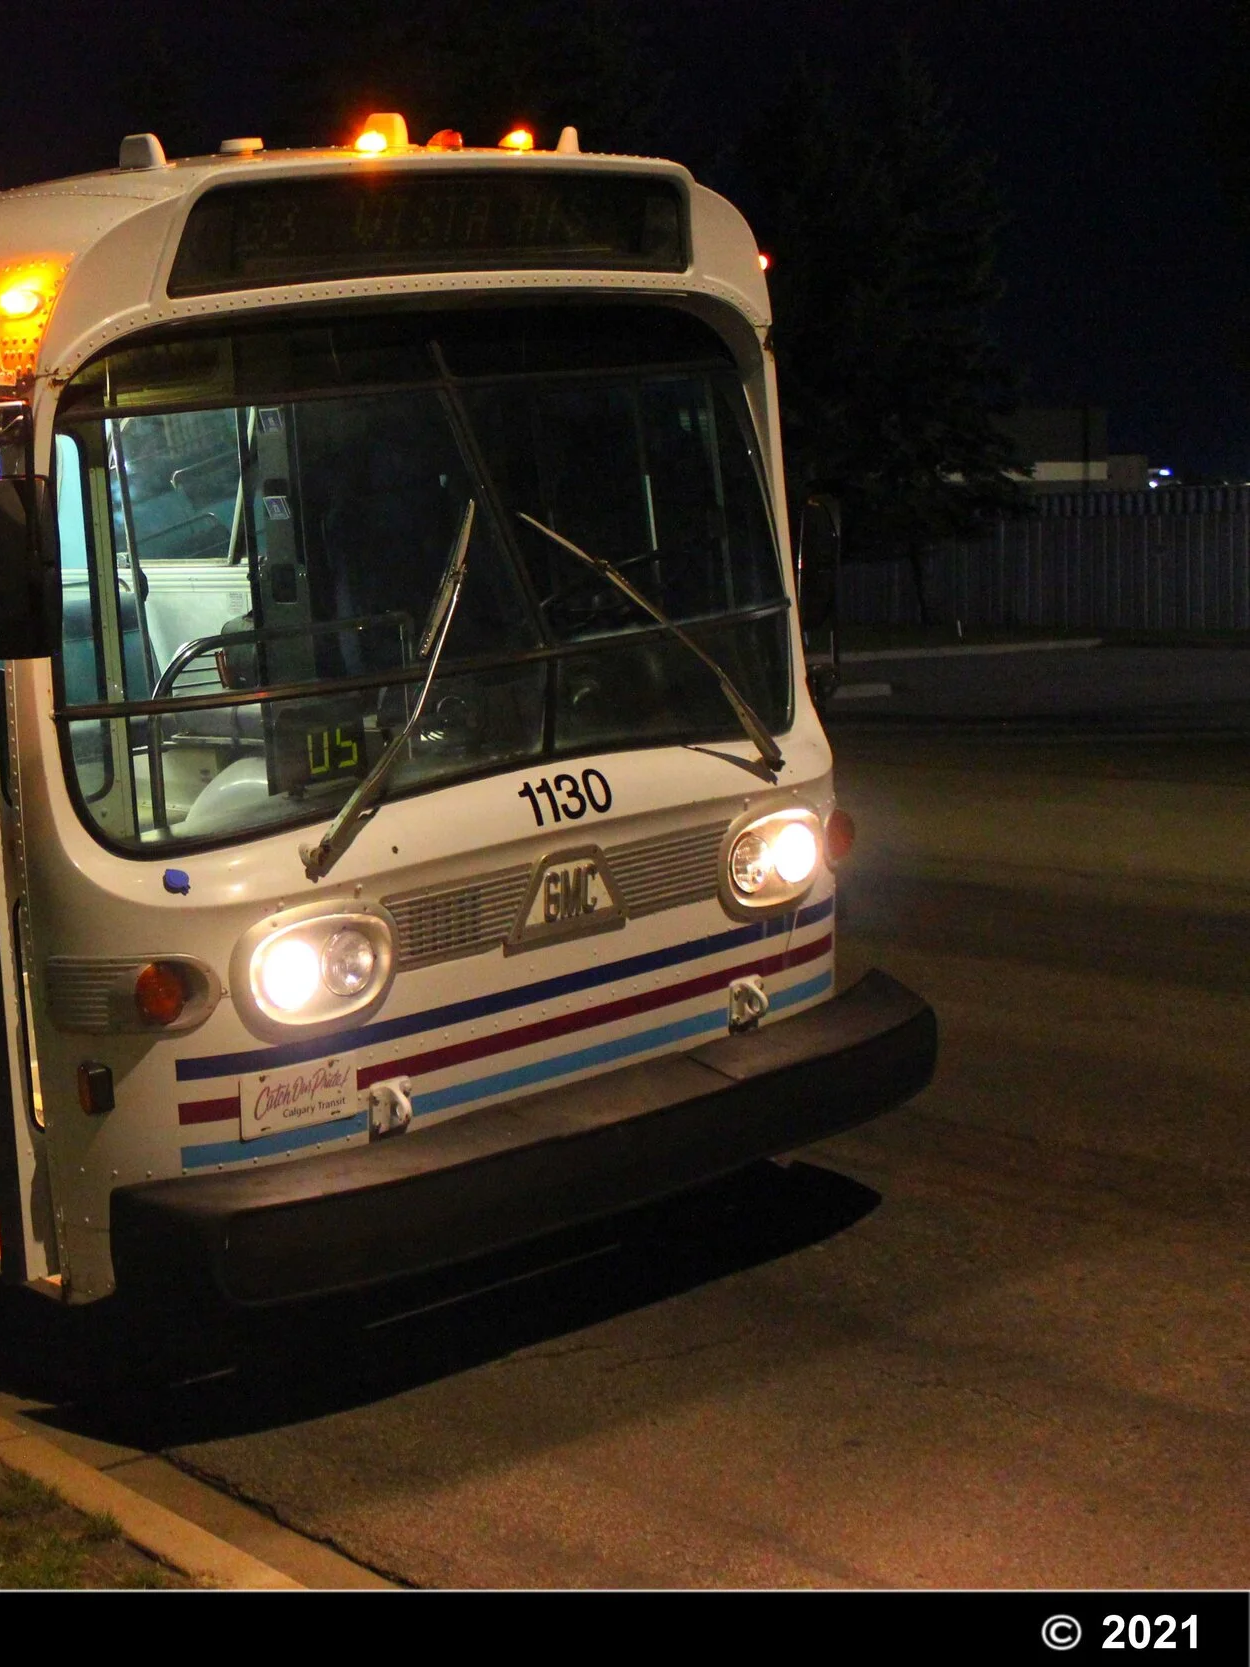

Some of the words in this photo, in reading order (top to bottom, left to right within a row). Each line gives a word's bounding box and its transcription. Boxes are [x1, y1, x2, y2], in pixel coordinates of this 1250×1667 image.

[518, 768, 612, 826] 1130
[543, 863, 598, 922] GMC
[254, 1083, 291, 1120] Catch
[283, 1105, 315, 1118] Calgary
[318, 1097, 346, 1110] Transit
